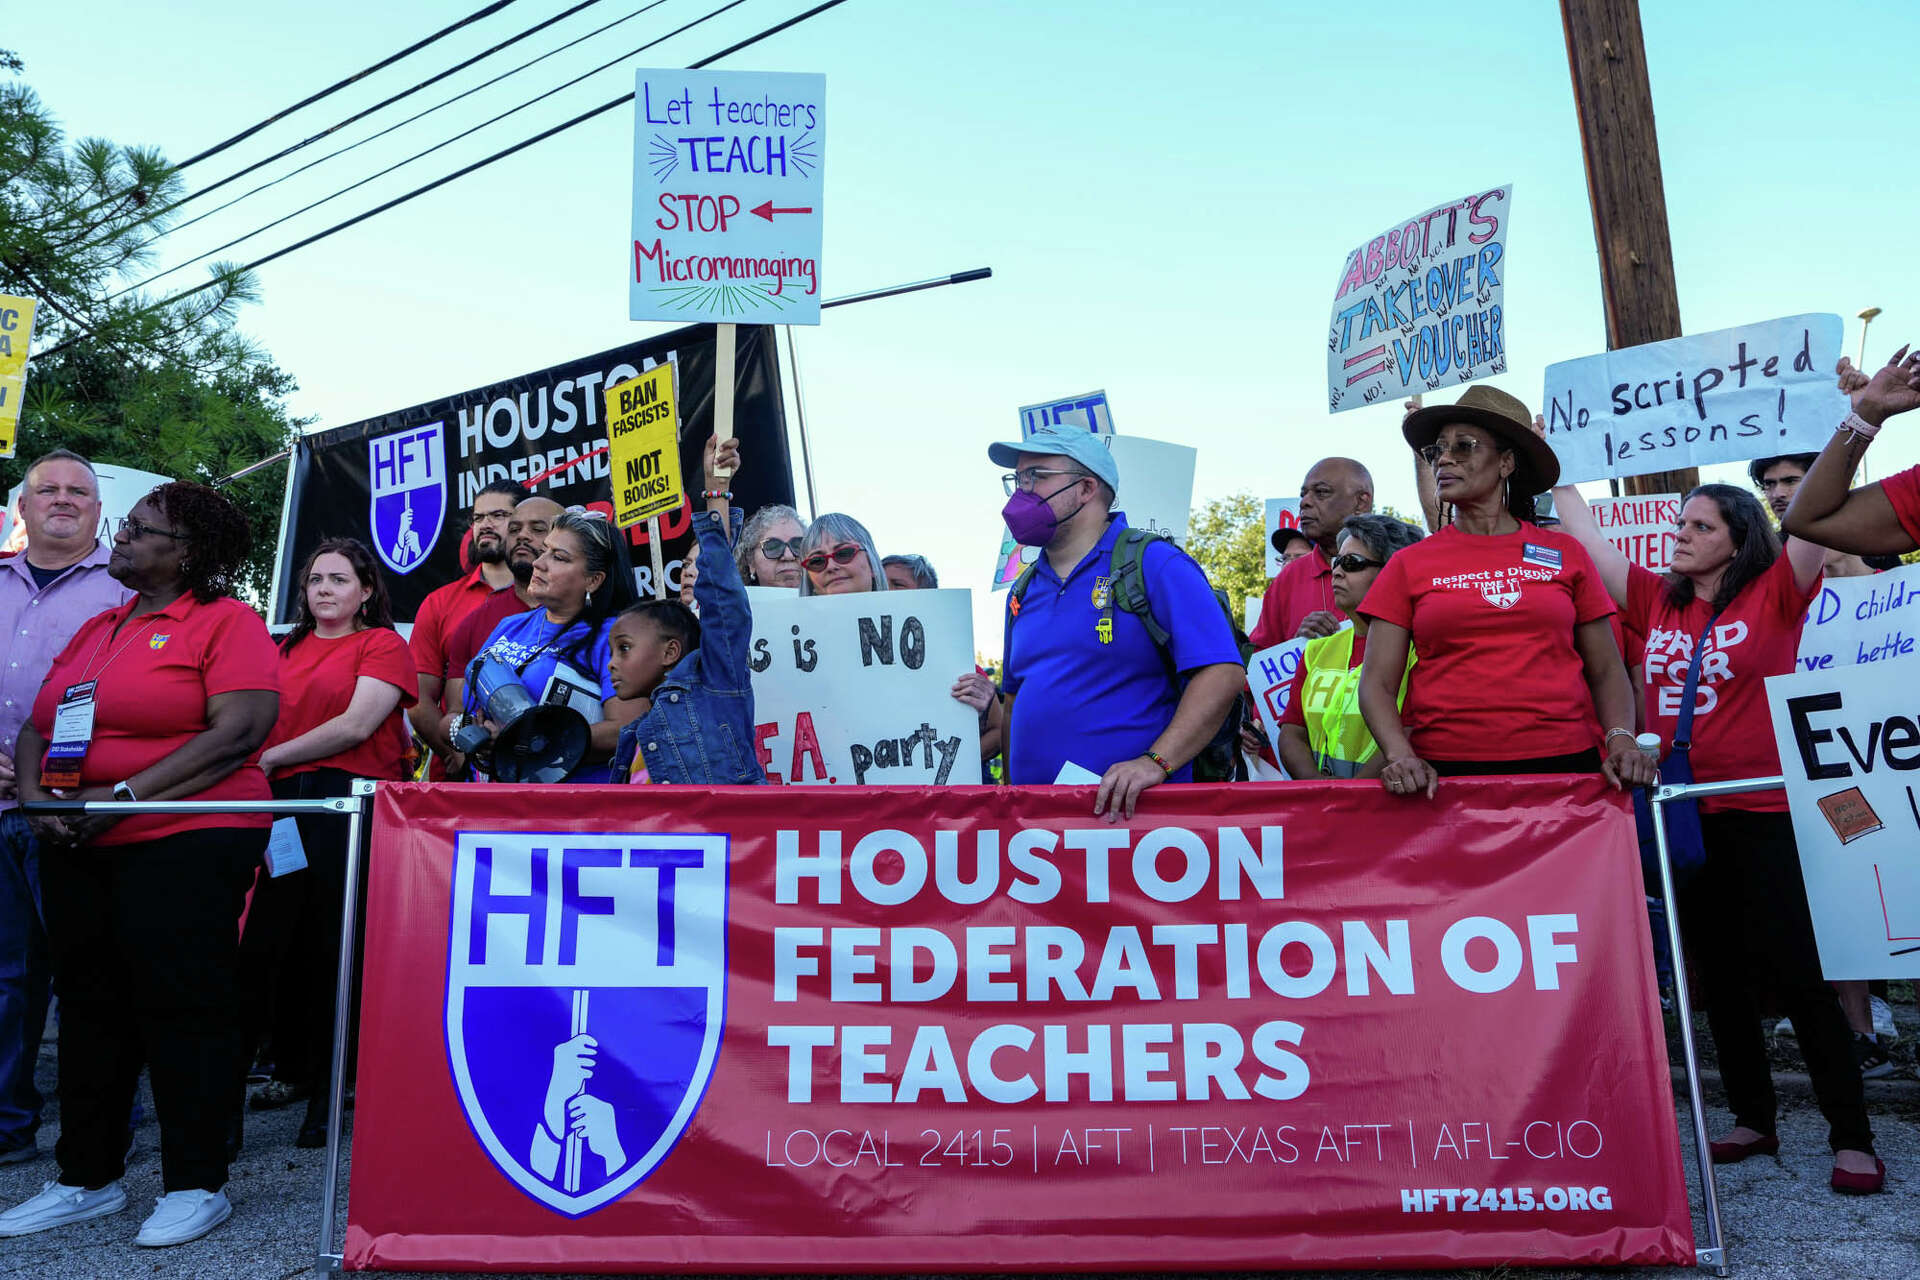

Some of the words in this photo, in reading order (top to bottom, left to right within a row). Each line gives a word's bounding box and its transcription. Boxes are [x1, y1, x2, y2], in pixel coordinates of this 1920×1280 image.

[644, 81, 693, 125] Let
[708, 86, 817, 130] teachers
[678, 135, 787, 177] TEACH
[656, 192, 741, 233] STOP
[634, 238, 817, 296] Micromanaging
[1334, 189, 1505, 302] ABBOTT'S
[1336, 241, 1503, 354] TAKEOVER
[1392, 303, 1504, 387] VOUCHER
[619, 378, 658, 416] BAN
[1550, 389, 1590, 434] No
[1611, 329, 1815, 421] scripted
[612, 401, 670, 439] FASCISTS
[1604, 388, 1787, 466] lessons!
[375, 428, 438, 490] HFT
[626, 449, 663, 486] NOT
[623, 475, 670, 507] BOOKS!
[1589, 499, 1680, 528] TEACHERS
[1432, 571, 1491, 586] Respect
[791, 624, 818, 673] is
[857, 615, 926, 670] NO
[1645, 650, 1736, 686] FOR
[1658, 685, 1719, 716] ED
[849, 722, 962, 786] party
[775, 825, 1285, 907] HOUSTON
[467, 847, 705, 967] HFT
[773, 918, 1416, 1003] FEDERATION
[1440, 912, 1579, 994] OF
[767, 1019, 1311, 1103] TEACHERS
[766, 1128, 904, 1168] LOCAL
[919, 1127, 1014, 1167] 2415
[1055, 1127, 1133, 1166] AFT
[1170, 1124, 1300, 1165] TEXAS
[1315, 1123, 1392, 1163] AFT
[1434, 1119, 1603, 1161] AFL-CIO
[1400, 1186, 1613, 1214] HFT2415.ORG
